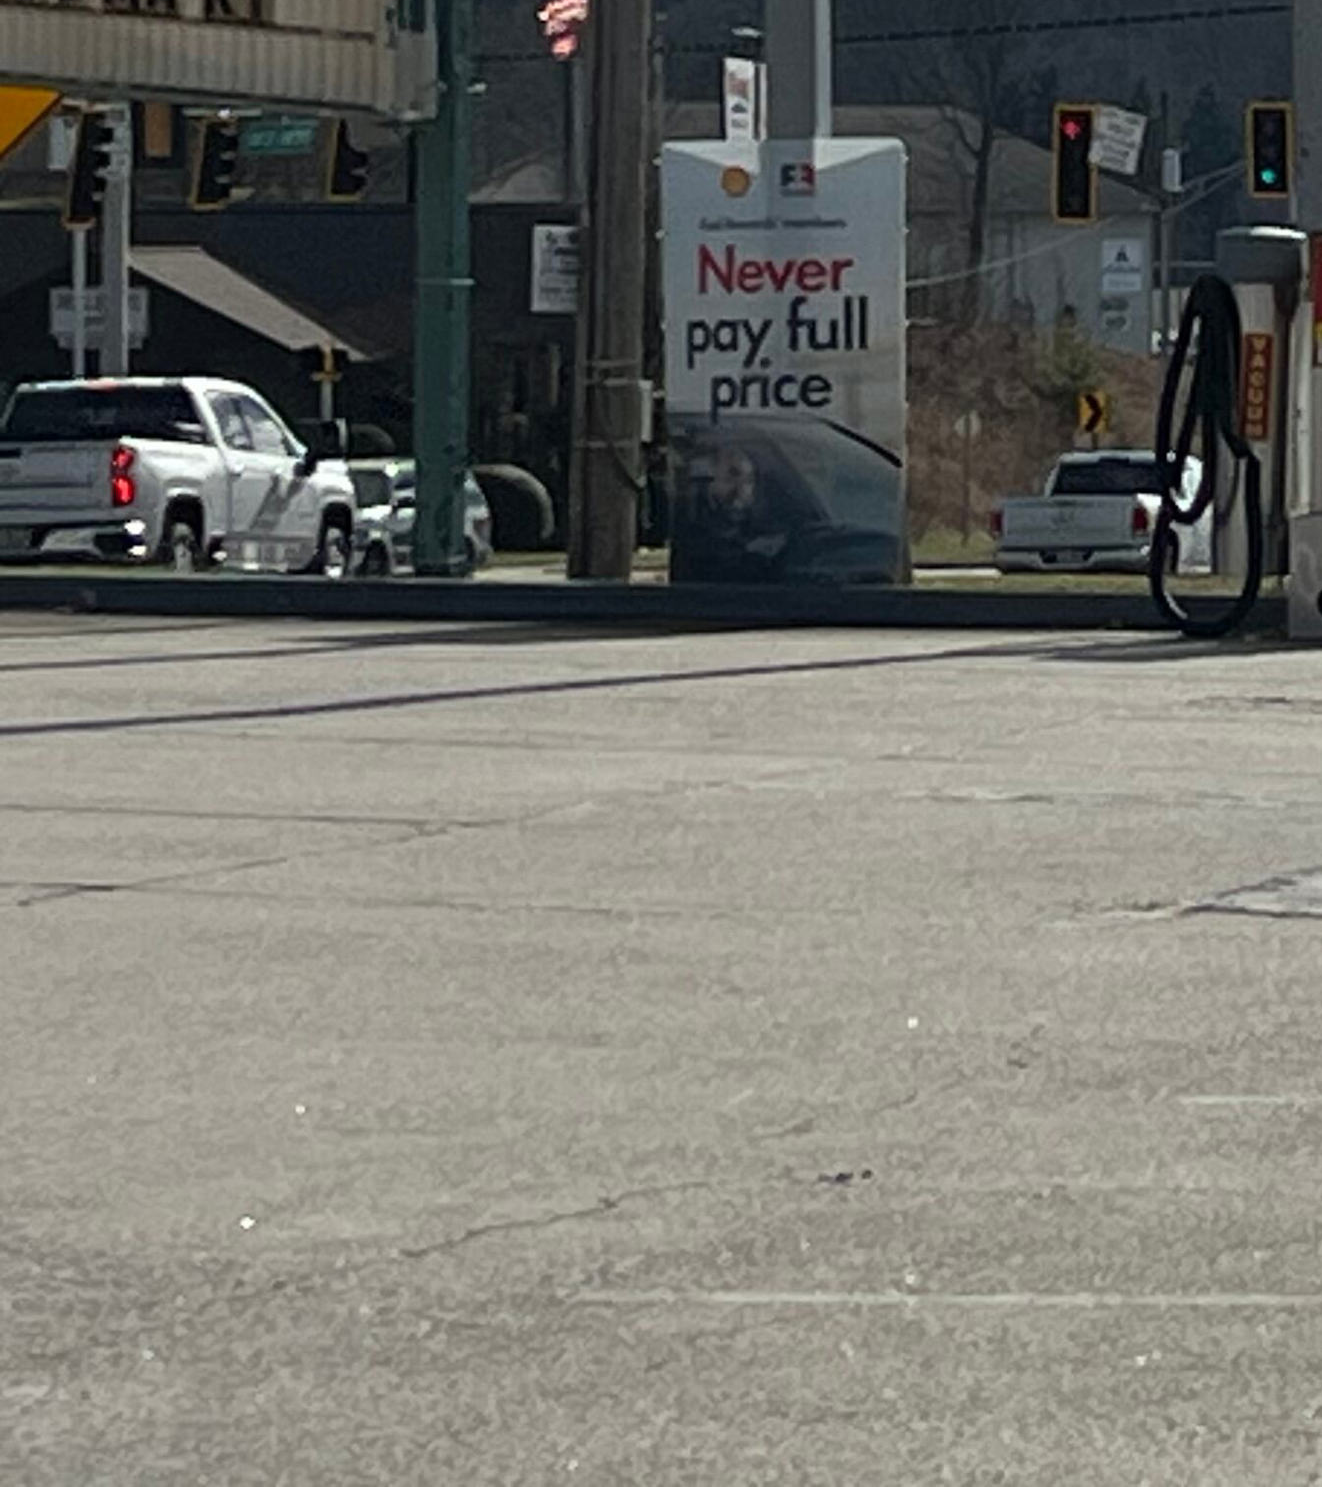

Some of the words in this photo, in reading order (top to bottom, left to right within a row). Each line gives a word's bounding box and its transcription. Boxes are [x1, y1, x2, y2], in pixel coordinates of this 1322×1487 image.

[698, 244, 854, 294] Never
[687, 318, 772, 369] pay
[787, 294, 869, 351] full
[710, 357, 833, 423] price
